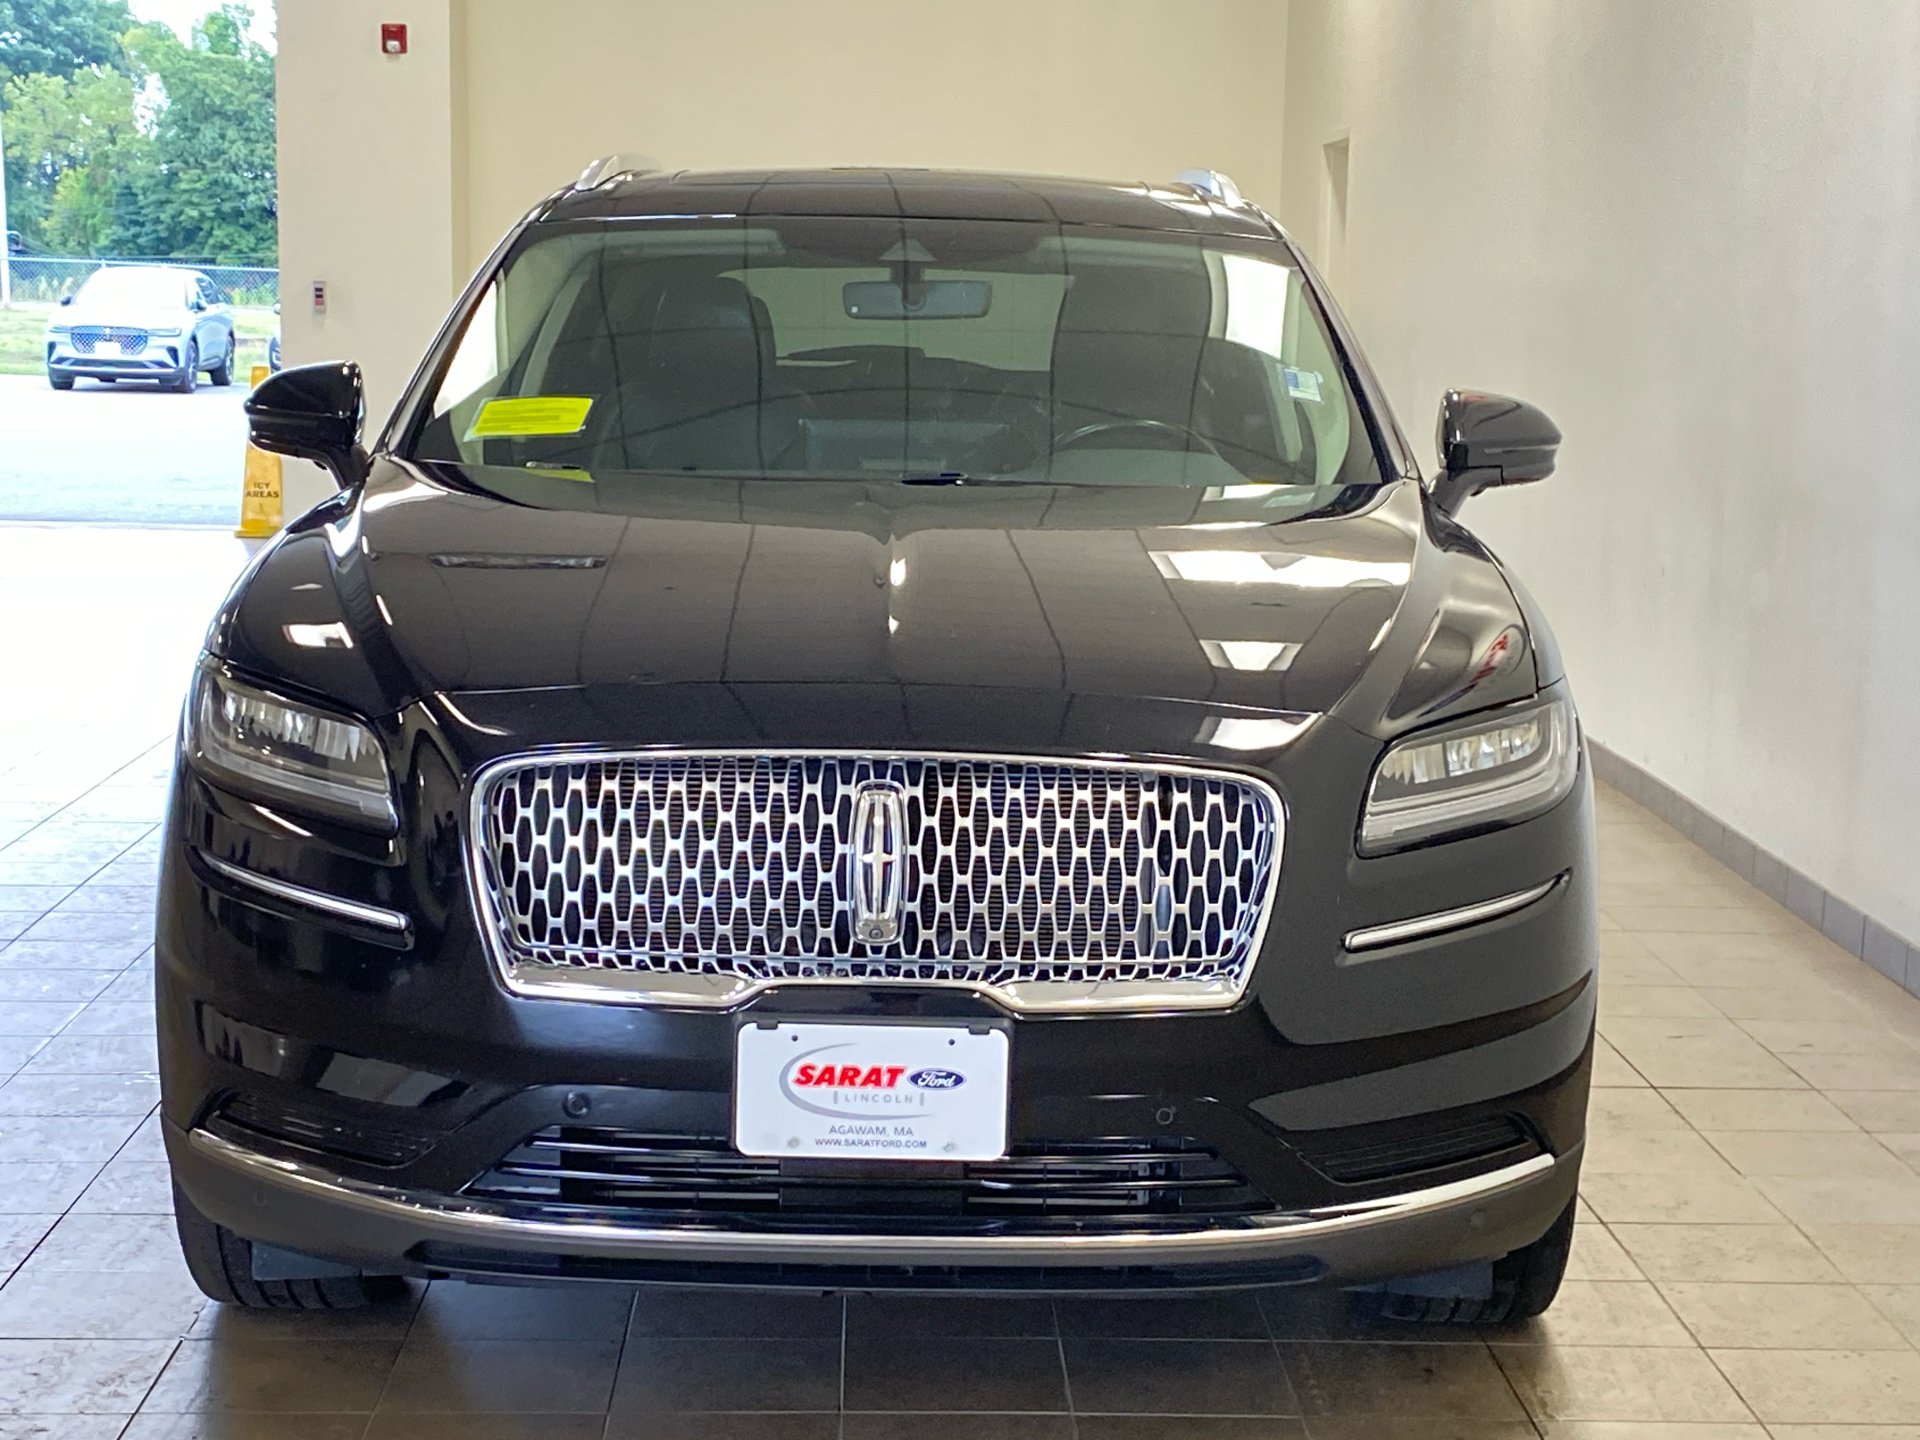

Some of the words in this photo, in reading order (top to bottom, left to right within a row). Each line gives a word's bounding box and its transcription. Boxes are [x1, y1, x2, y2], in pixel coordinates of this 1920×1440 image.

[246, 490, 280, 498] AREAS
[792, 1062, 907, 1089] SARAT
[917, 1071, 955, 1088] Ford
[844, 1093, 914, 1104] LINCOLN
[828, 1125, 889, 1137] AGAWAM,
[893, 1126, 914, 1137] MA
[814, 1138, 928, 1149] WWW.SARATFORD.COM
